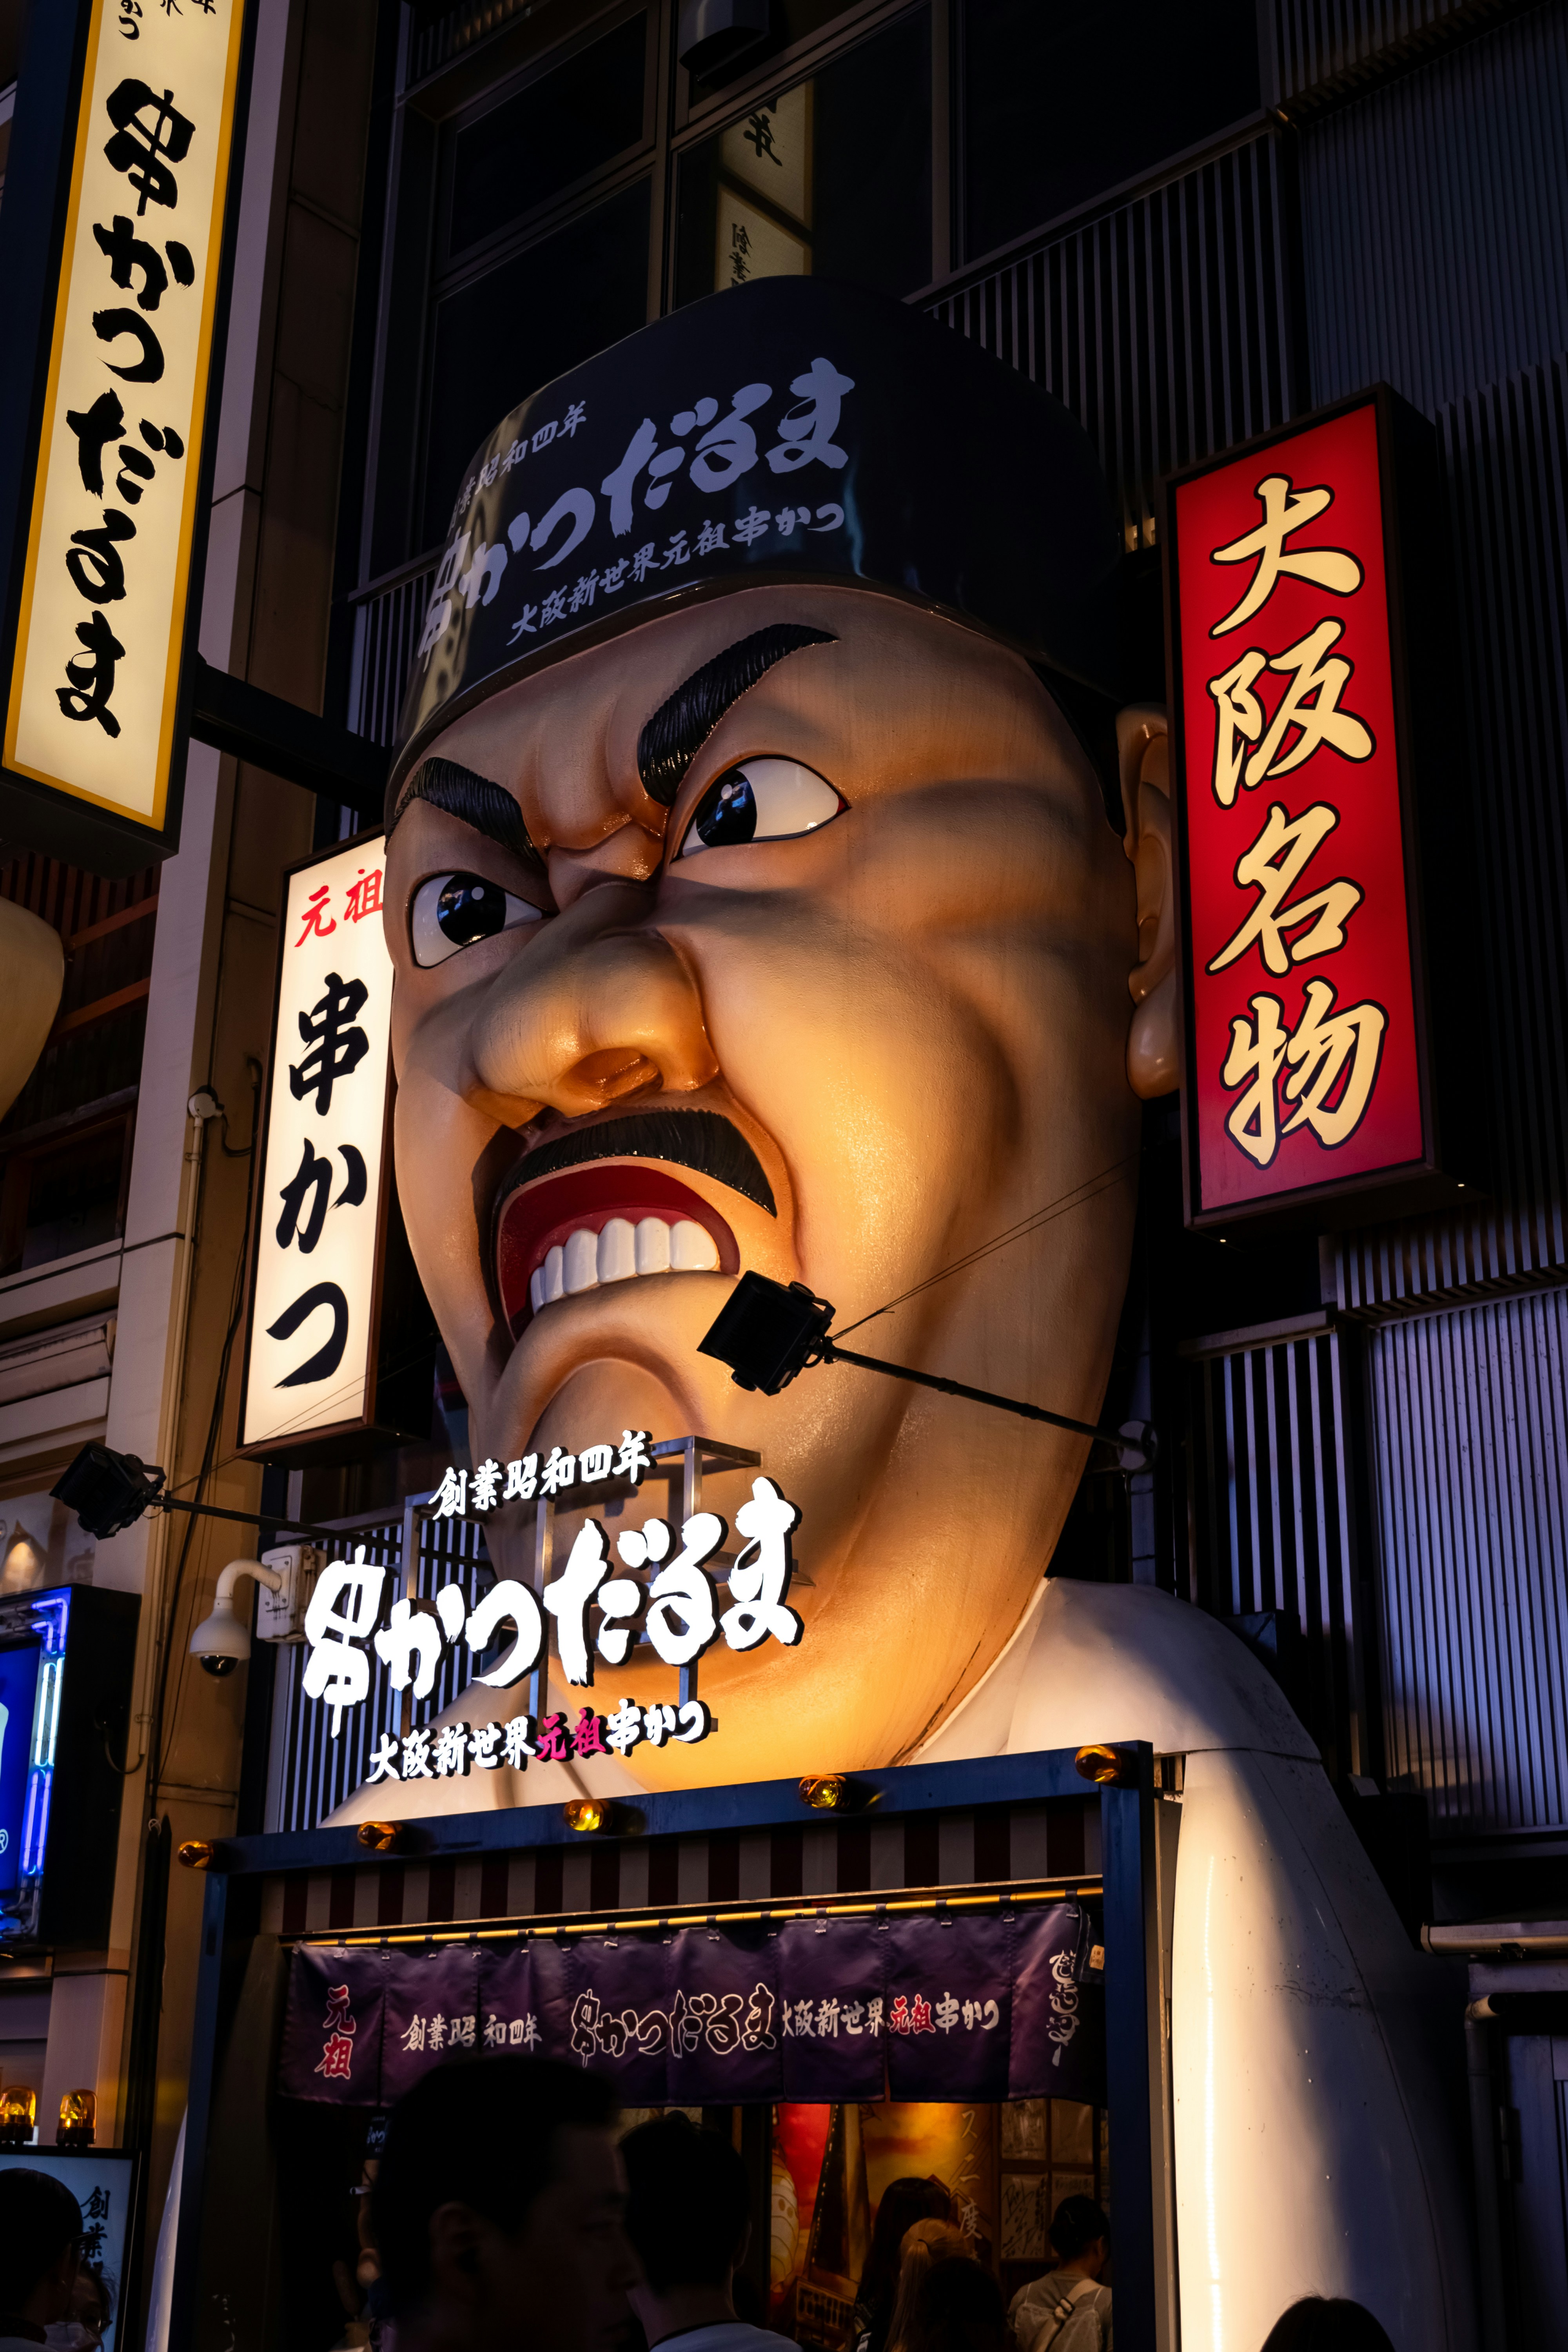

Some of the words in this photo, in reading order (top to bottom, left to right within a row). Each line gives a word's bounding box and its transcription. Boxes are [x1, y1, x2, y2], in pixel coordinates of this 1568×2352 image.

[55, 78, 196, 739] 串かつだるま
[417, 358, 855, 673] 串かつだるま
[506, 503, 845, 645] 大阪新世界元祖串かつ
[1209, 474, 1387, 1167] 大阪名物
[294, 869, 383, 947] 元祖
[265, 972, 368, 1388] 串かつ
[428, 1430, 652, 1520] 創業昭和四年
[302, 1476, 799, 1739] 串かつだるま
[365, 1699, 706, 1784] 大阪新世界元祖串かつ
[314, 1984, 357, 2080] 元祖
[401, 2012, 543, 2052] 創業昭和四年
[570, 1982, 776, 2068] 串かつだるま
